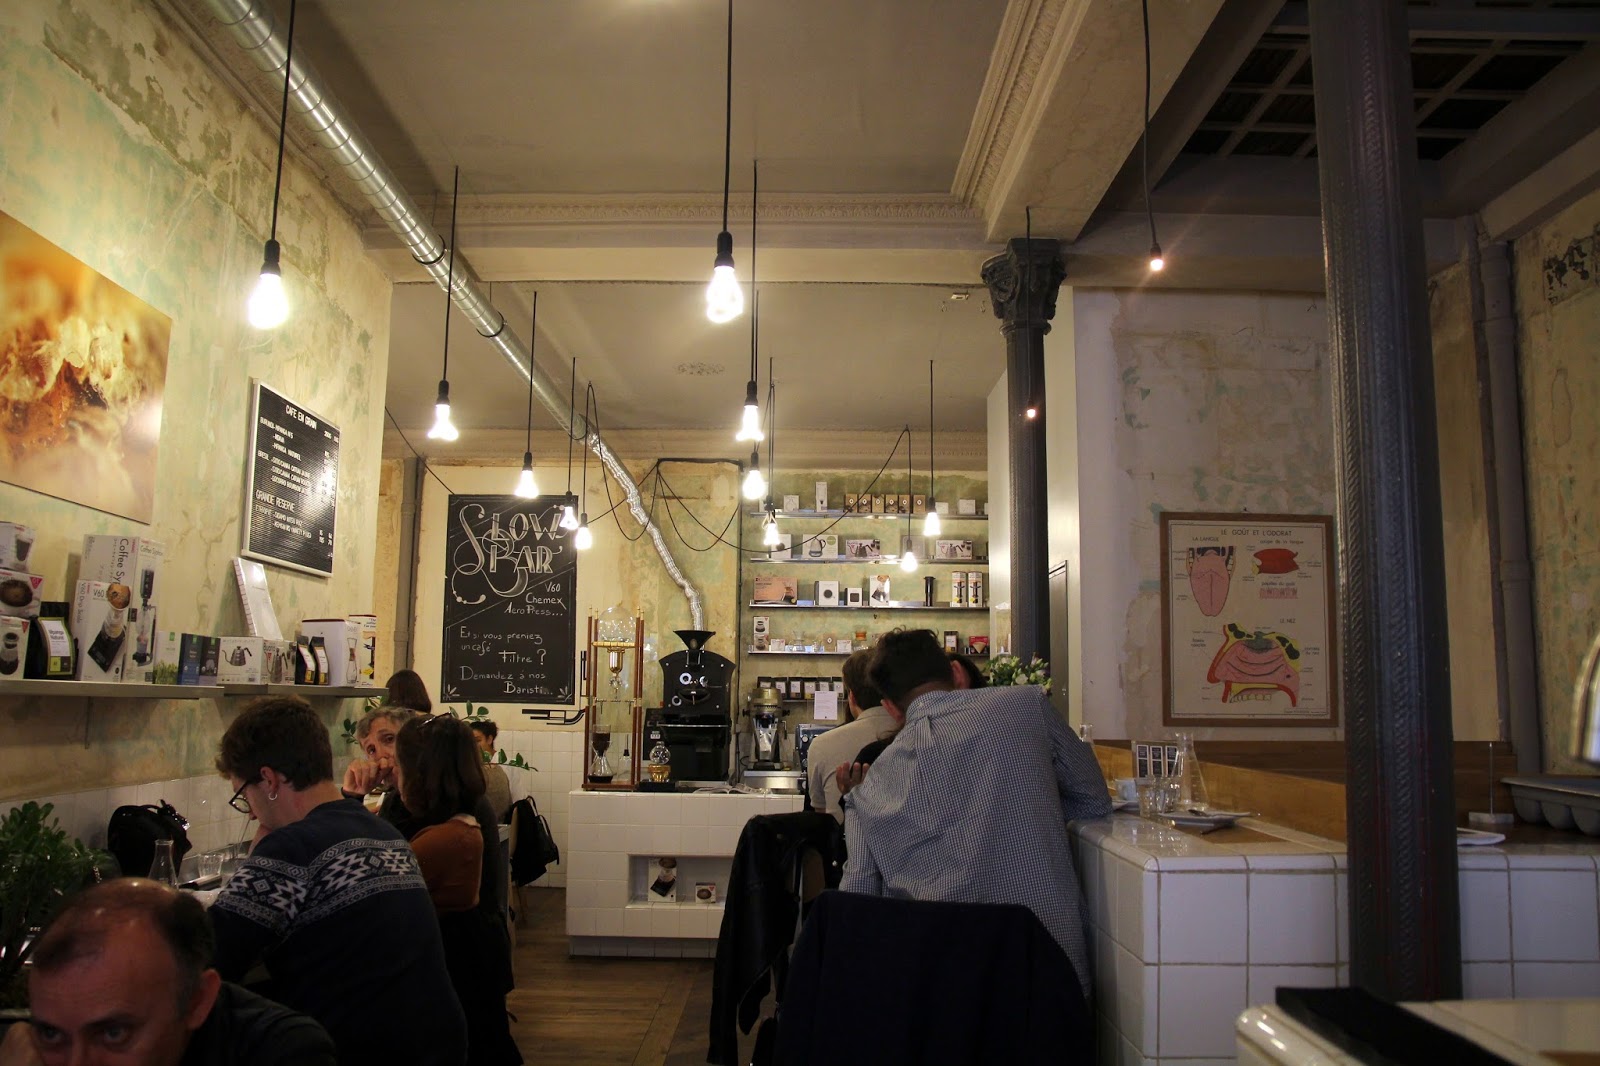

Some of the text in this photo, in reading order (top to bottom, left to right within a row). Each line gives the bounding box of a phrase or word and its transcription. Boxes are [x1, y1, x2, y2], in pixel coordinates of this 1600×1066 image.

[285, 404, 318, 430] CAFE EN GRAIN
[255, 489, 296, 513] GRANDE RESERVE
[456, 504, 562, 575] SLOW
[1232, 528, 1249, 536] GOÛT
[1262, 529, 1292, 537] L'ODORAT
[118, 538, 129, 568] Coffee
[93, 589, 105, 598] V60
[545, 581, 561, 593] V60
[525, 592, 567, 610] Chemex
[460, 626, 471, 638] Et
[507, 633, 543, 645] preniez
[472, 640, 492, 657] café
[498, 649, 546, 666] Filtre ?
[459, 665, 513, 681] Demandez
